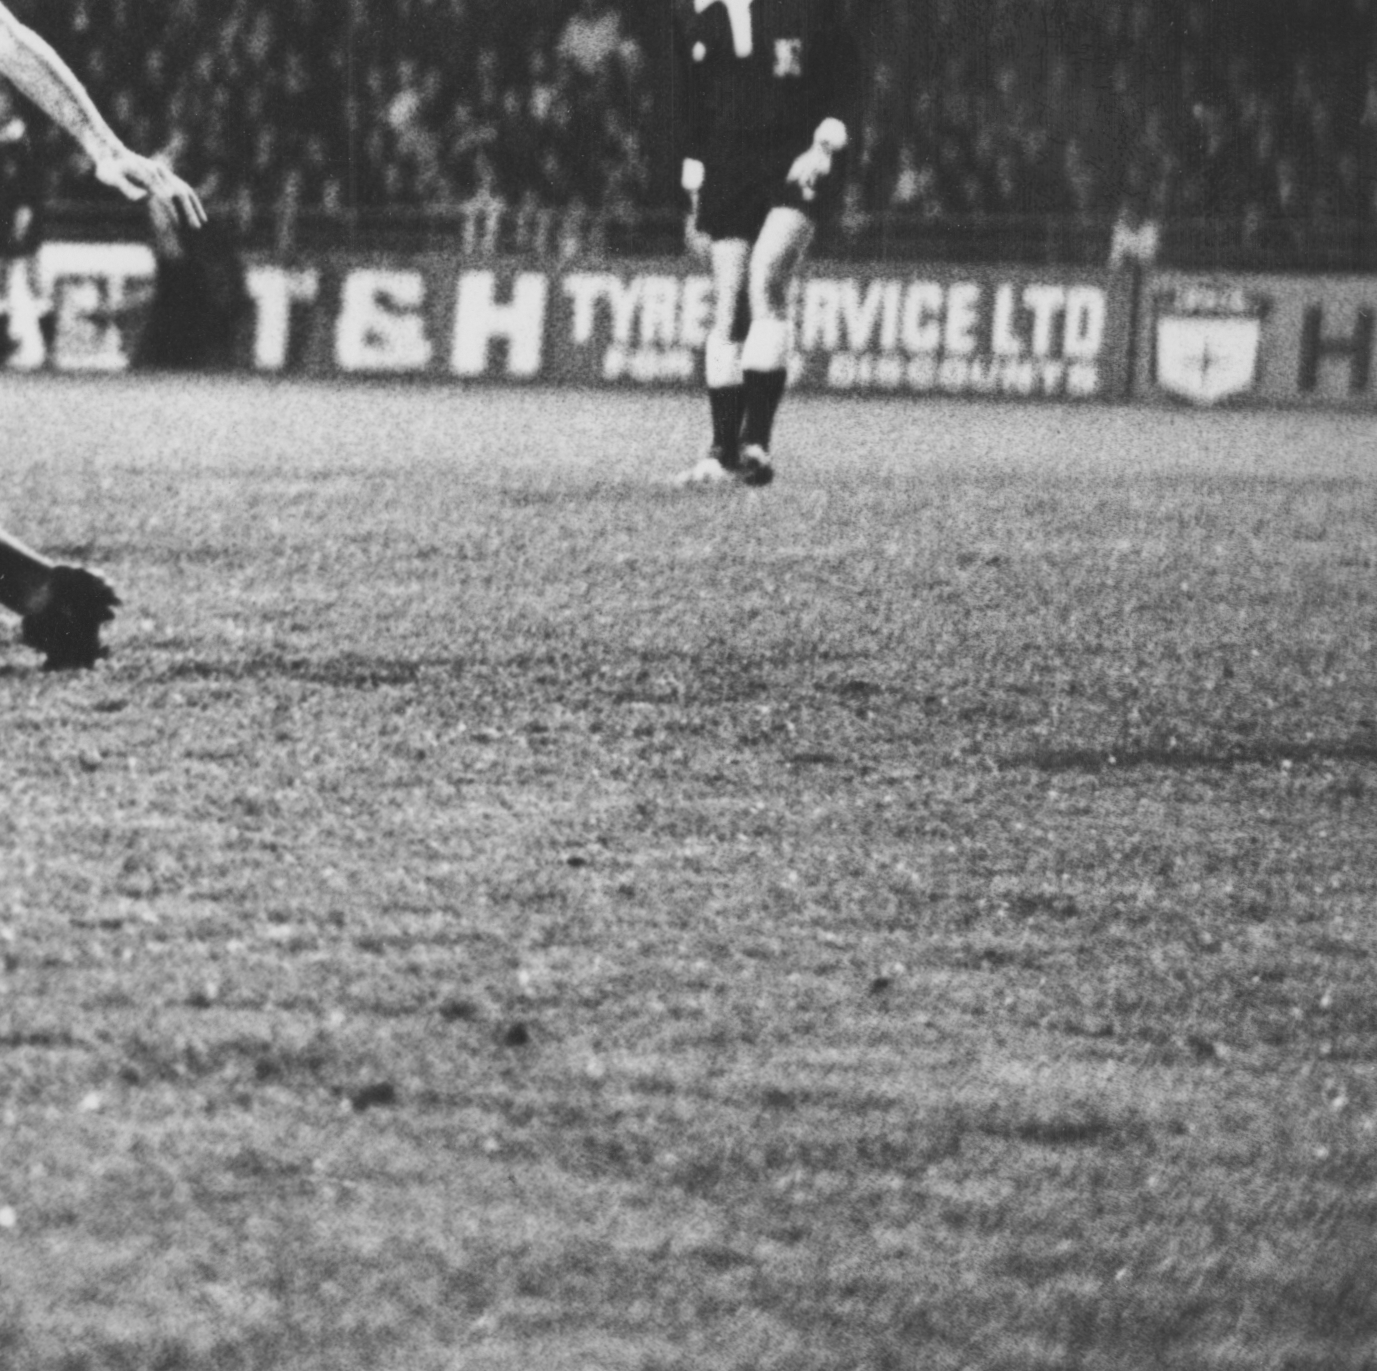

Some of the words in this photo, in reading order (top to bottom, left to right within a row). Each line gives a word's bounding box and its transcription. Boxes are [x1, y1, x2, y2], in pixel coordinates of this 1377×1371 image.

[246, 264, 320, 372] T
[336, 267, 432, 373] &
[451, 268, 548, 377] H
[563, 270, 713, 349] TYRE
[992, 283, 1108, 361] LTD
